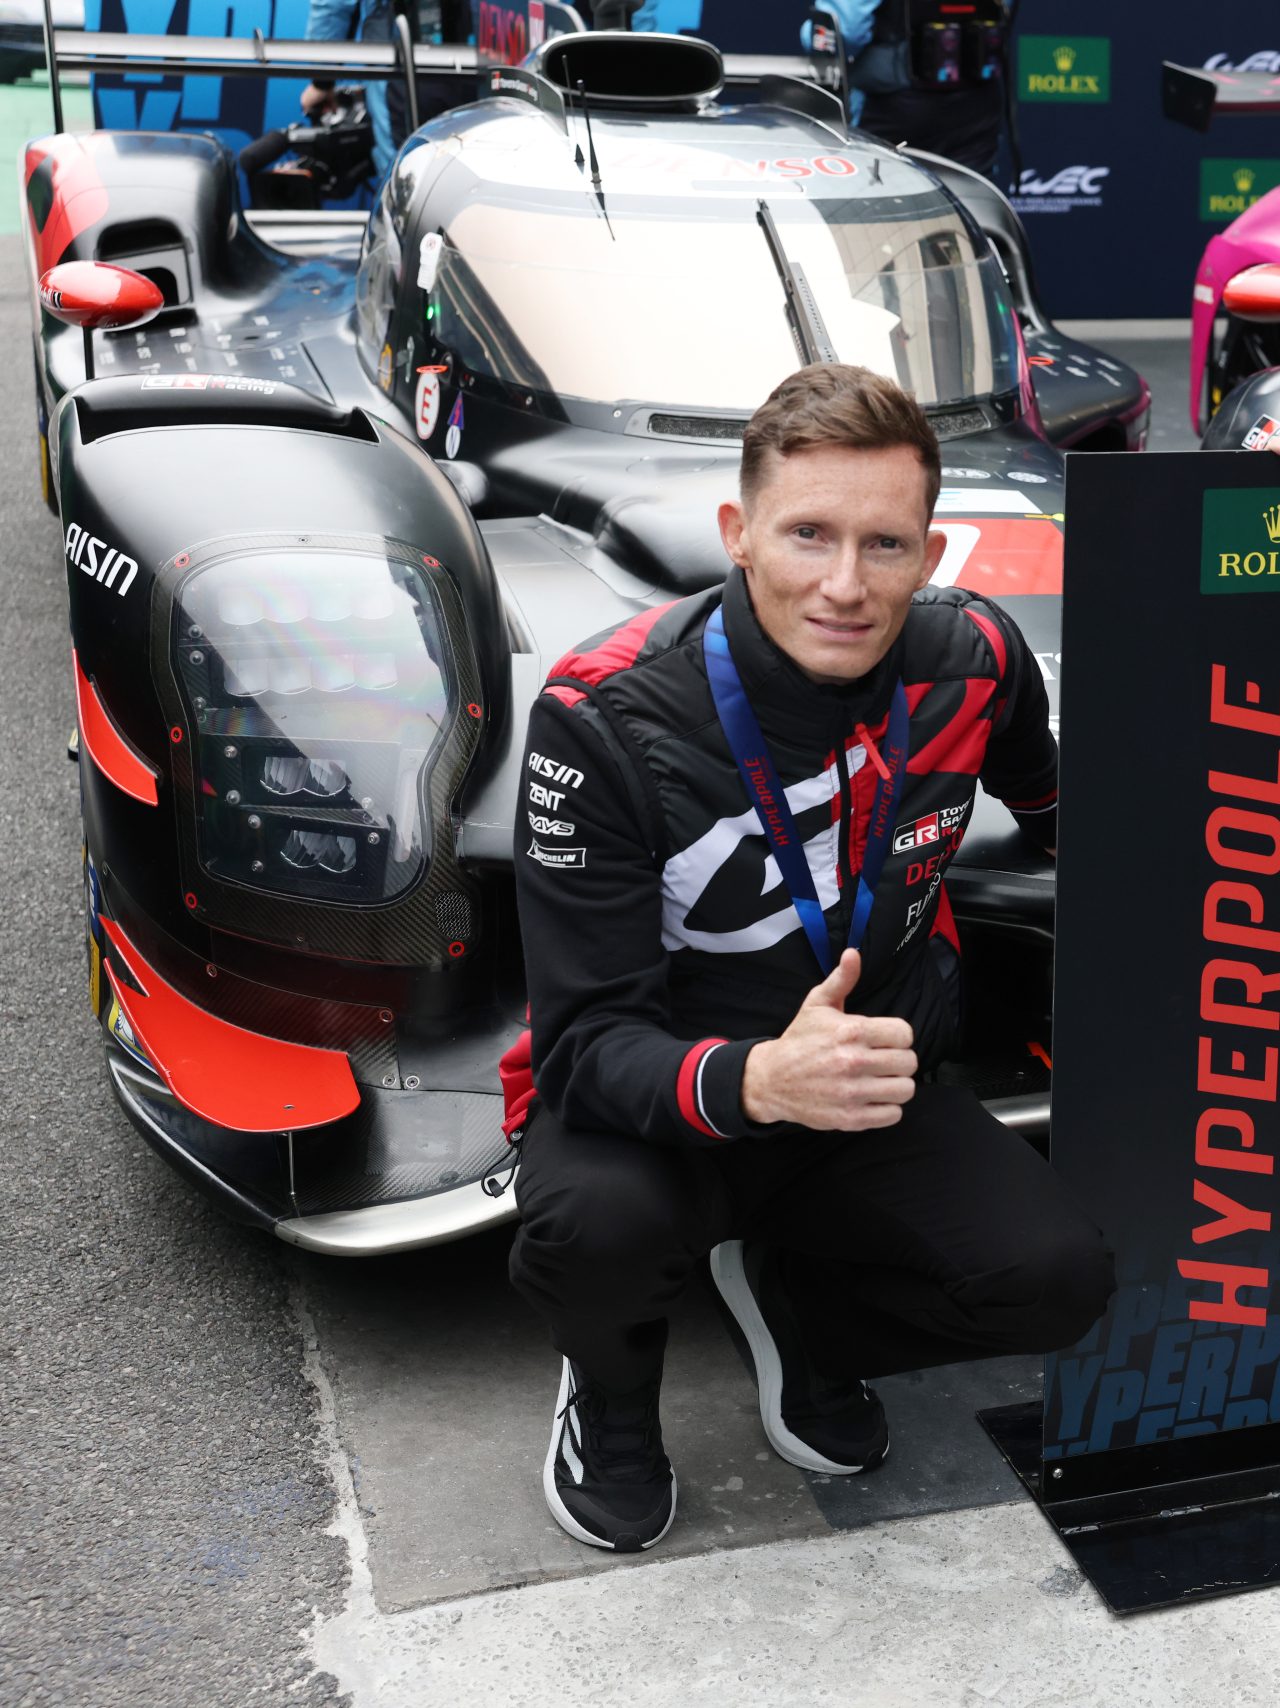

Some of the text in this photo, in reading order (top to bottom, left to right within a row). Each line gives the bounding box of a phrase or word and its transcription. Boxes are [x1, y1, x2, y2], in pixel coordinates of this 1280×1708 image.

[1028, 74, 1100, 93] ROLEX
[66, 522, 139, 597] AISIN
[529, 752, 585, 789] AISIN
[529, 781, 566, 812] ZENT
[744, 757, 790, 847] HYPERPOLE
[894, 819, 939, 853] GR
